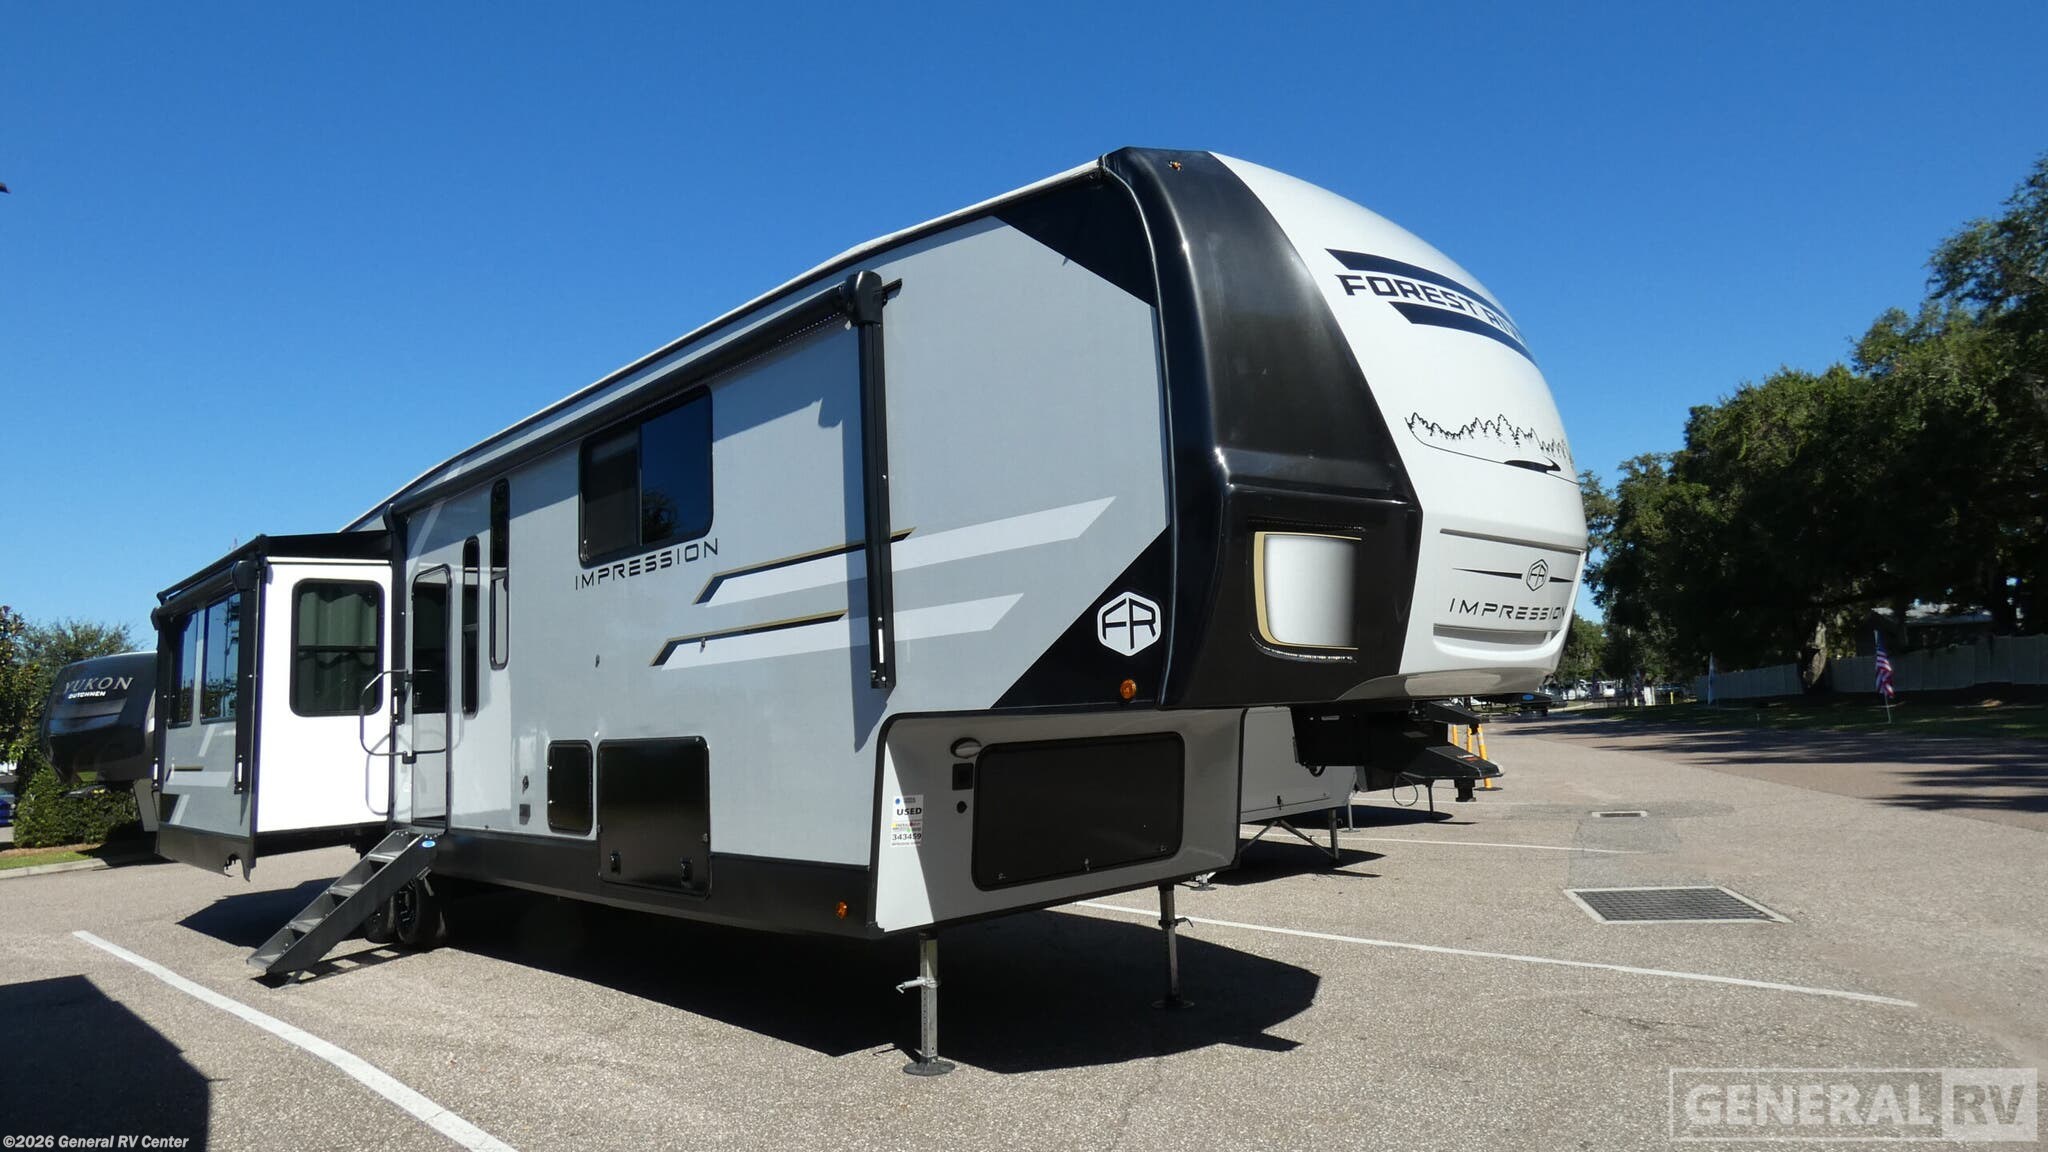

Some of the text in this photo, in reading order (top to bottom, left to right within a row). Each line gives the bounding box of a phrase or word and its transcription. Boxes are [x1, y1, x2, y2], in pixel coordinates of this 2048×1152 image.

[1335, 274, 1478, 315] FOREST
[574, 537, 719, 592] IMPRESSION
[64, 676, 133, 694] YUKON
[896, 807, 922, 816] USED
[892, 832, 922, 841] 343459
